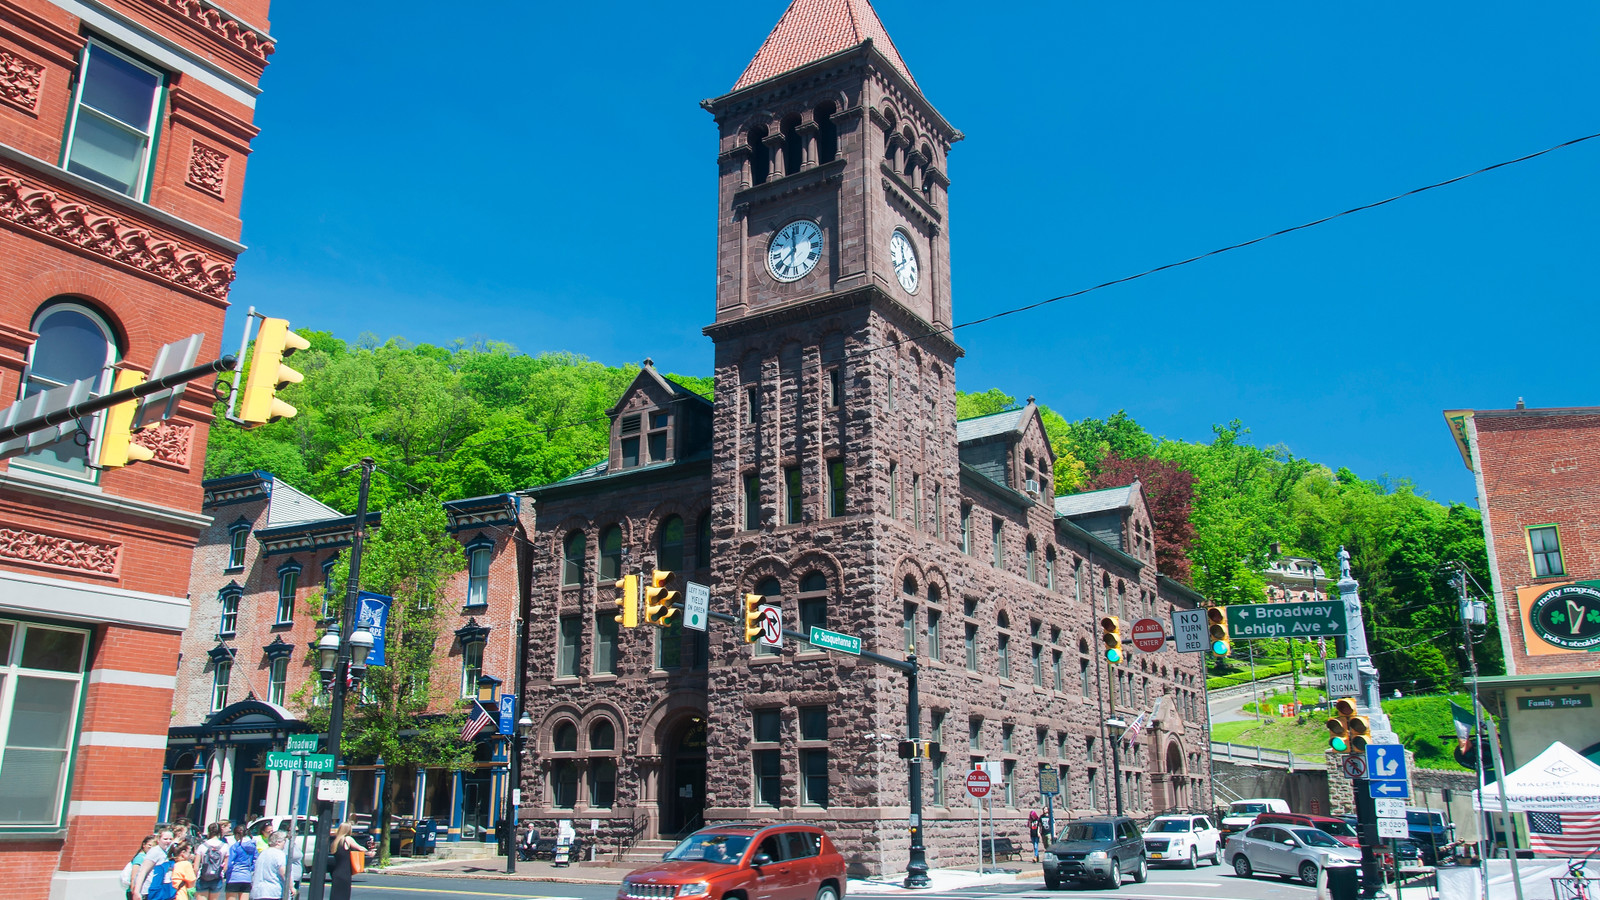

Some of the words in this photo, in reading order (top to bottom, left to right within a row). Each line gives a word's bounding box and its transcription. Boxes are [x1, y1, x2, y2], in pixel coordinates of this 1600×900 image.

[691, 596, 704, 606] YIELD
[1538, 589, 1562, 606] molly
[694, 605, 705, 614] GREEN
[1255, 606, 1332, 618] Broadway
[1180, 614, 1199, 624] NO
[1180, 624, 1202, 632] TURN
[1234, 622, 1286, 636] Lehigh
[1292, 622, 1321, 633] Ave
[820, 632, 852, 648] Susquehanna
[852, 639, 858, 650] St
[1543, 633, 1560, 644] pub
[1330, 662, 1353, 670] RIGHT
[1334, 673, 1354, 681] TURN
[1330, 684, 1358, 692] SIGNAL
[1528, 699, 1554, 707] Family
[1560, 698, 1582, 706] Trips
[287, 736, 316, 750] Broadway
[324, 758, 332, 768] ST
